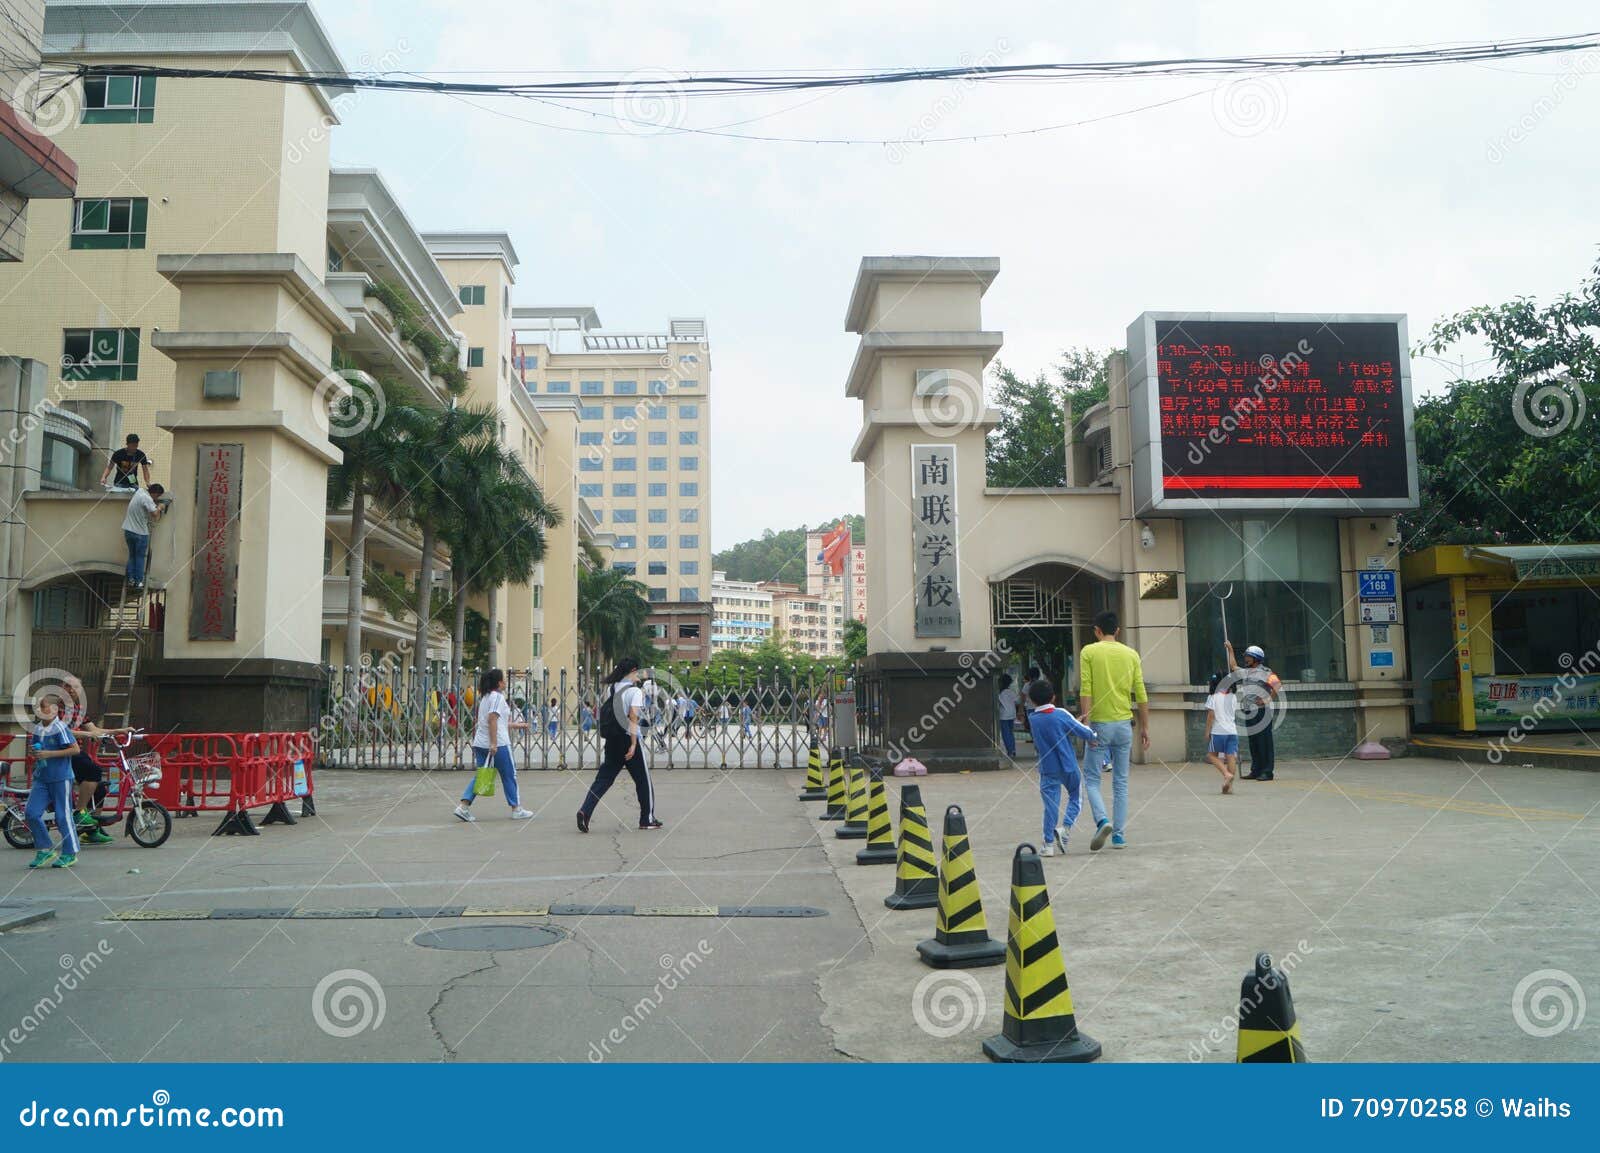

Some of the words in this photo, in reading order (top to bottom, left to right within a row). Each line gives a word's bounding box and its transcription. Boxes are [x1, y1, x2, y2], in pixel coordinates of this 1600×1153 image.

[919, 454, 953, 607] 南联学校
[1370, 580, 1387, 591] 168
